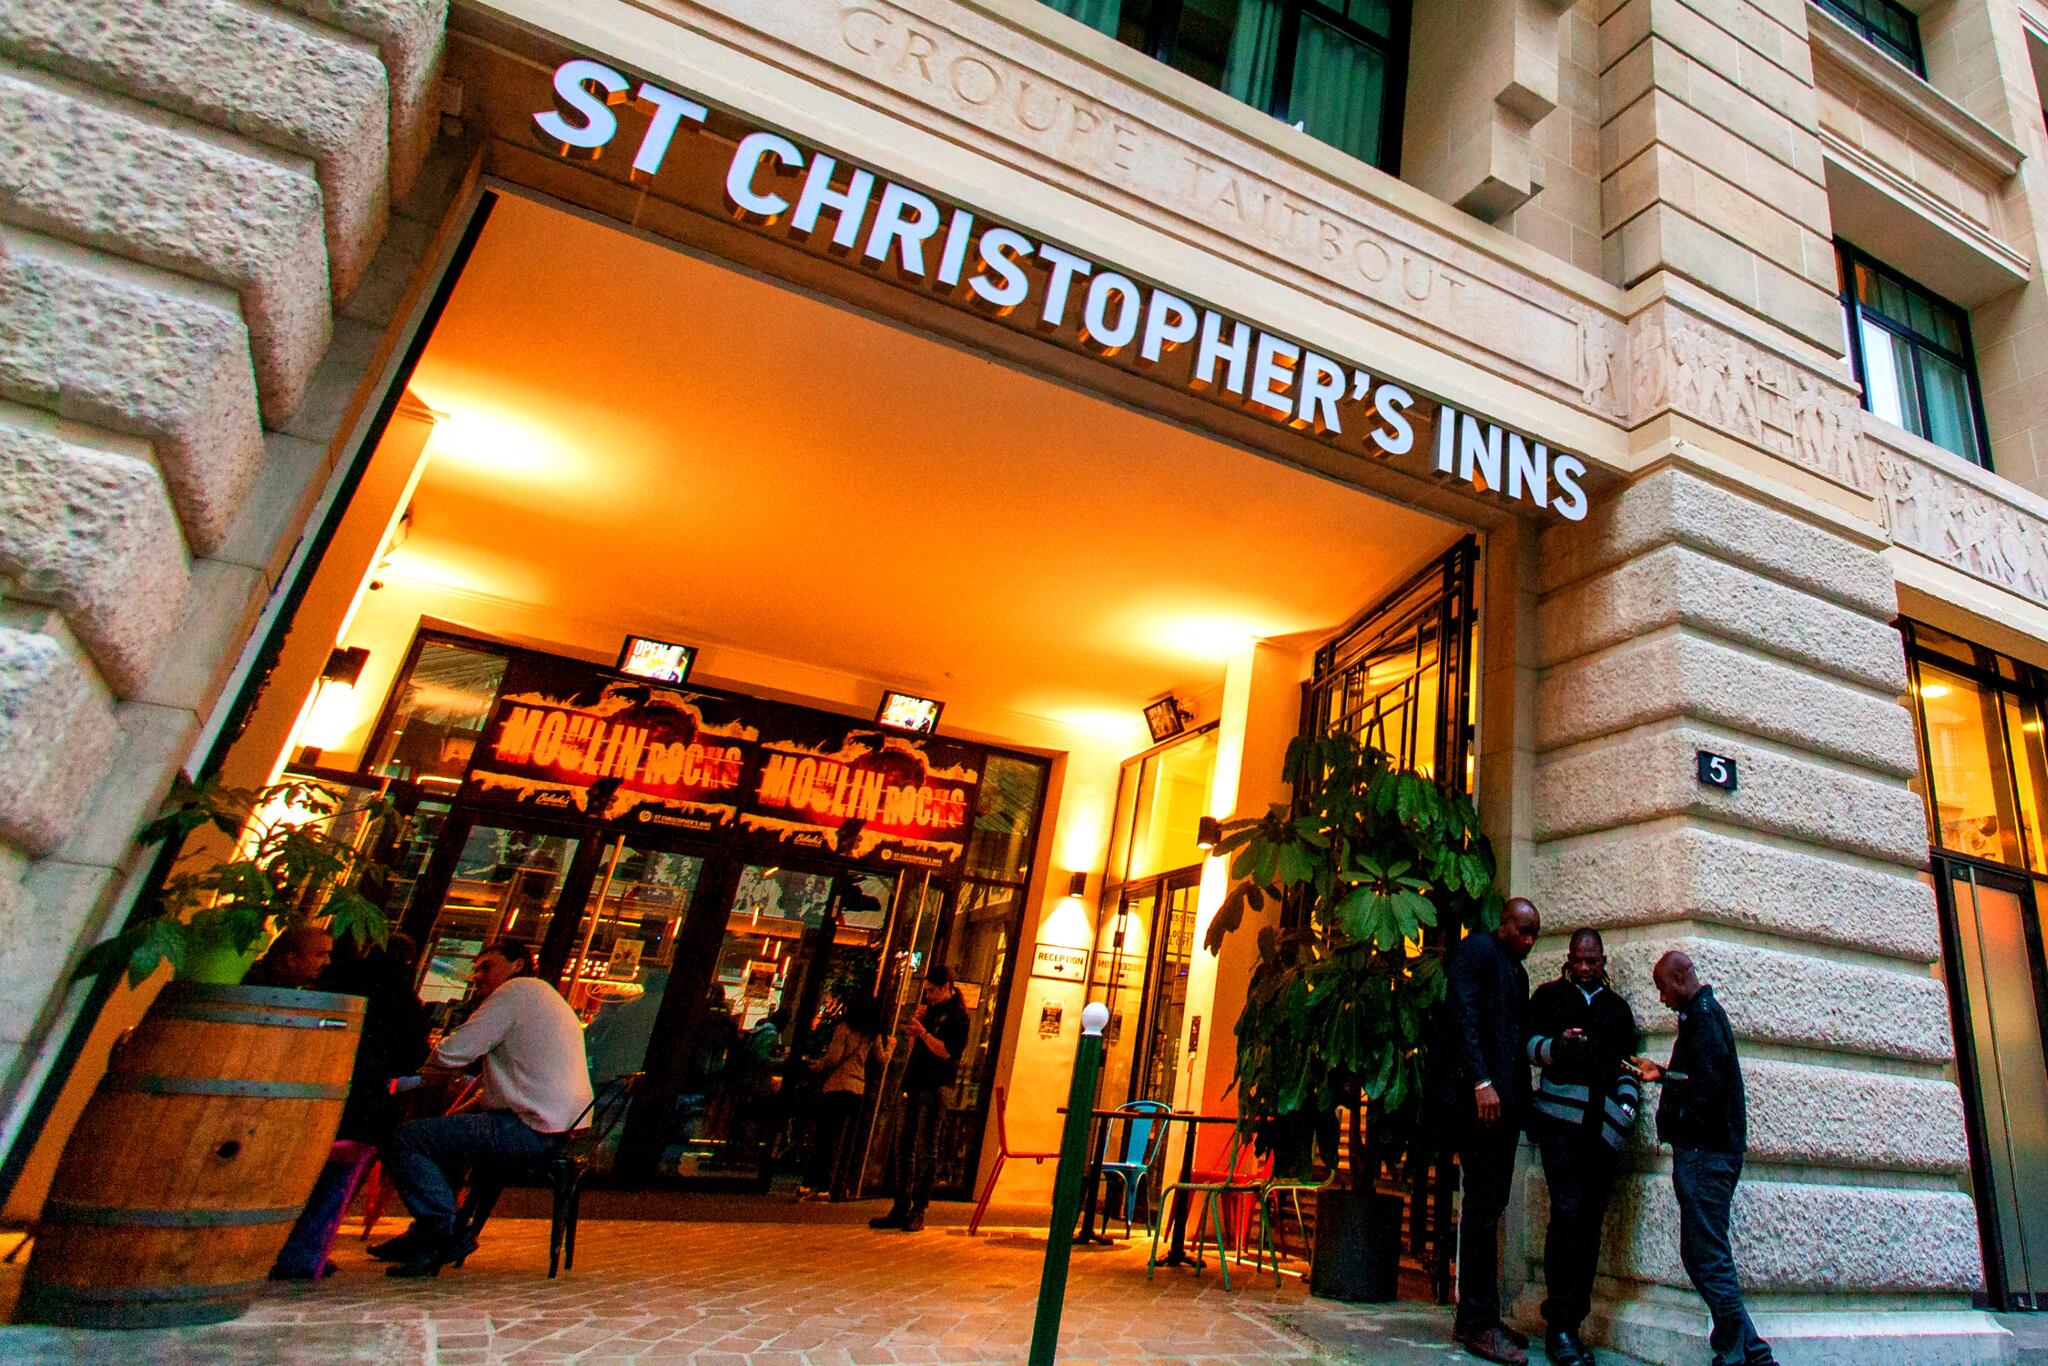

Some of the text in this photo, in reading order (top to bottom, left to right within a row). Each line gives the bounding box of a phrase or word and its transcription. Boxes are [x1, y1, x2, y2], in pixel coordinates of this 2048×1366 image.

[838, 5, 1466, 302] GROUPE TAITBOUT
[532, 59, 1589, 522] ST CHRISTOPHER'S INNS
[495, 706, 649, 781] MOULIN
[1710, 756, 1728, 783] 5
[757, 753, 885, 821] MOULIN
[1037, 952, 1084, 966] RECEPTION
